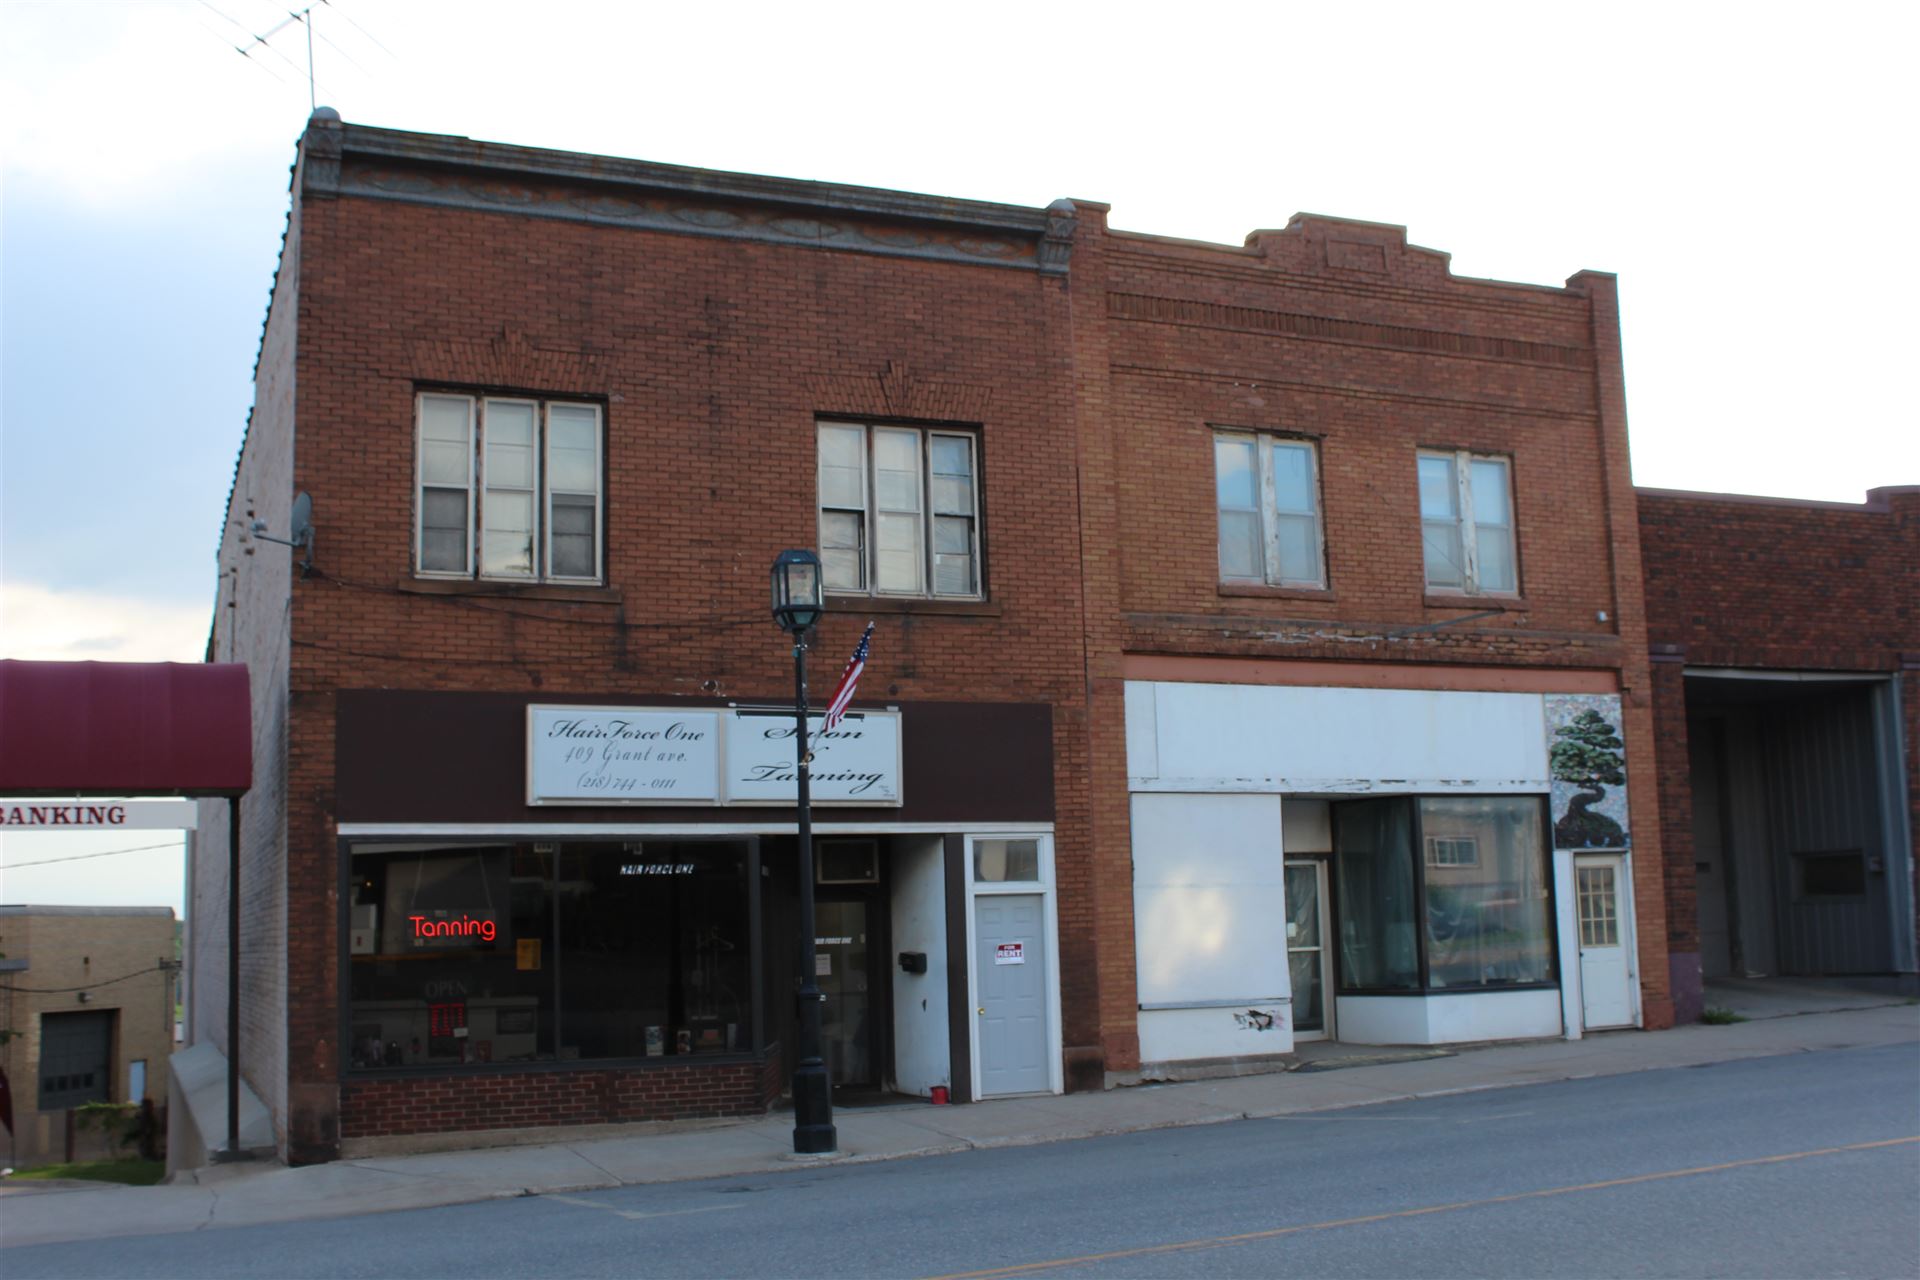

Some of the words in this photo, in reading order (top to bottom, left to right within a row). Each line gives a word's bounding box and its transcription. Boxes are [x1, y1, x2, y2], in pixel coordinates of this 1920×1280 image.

[664, 721, 705, 741] One
[565, 746, 595, 764] 409
[602, 740, 653, 772] Grant
[656, 751, 688, 762] ave.
[0, 806, 126, 825] ANKING
[409, 914, 496, 941] Tanning
[997, 949, 1022, 957] RENT
